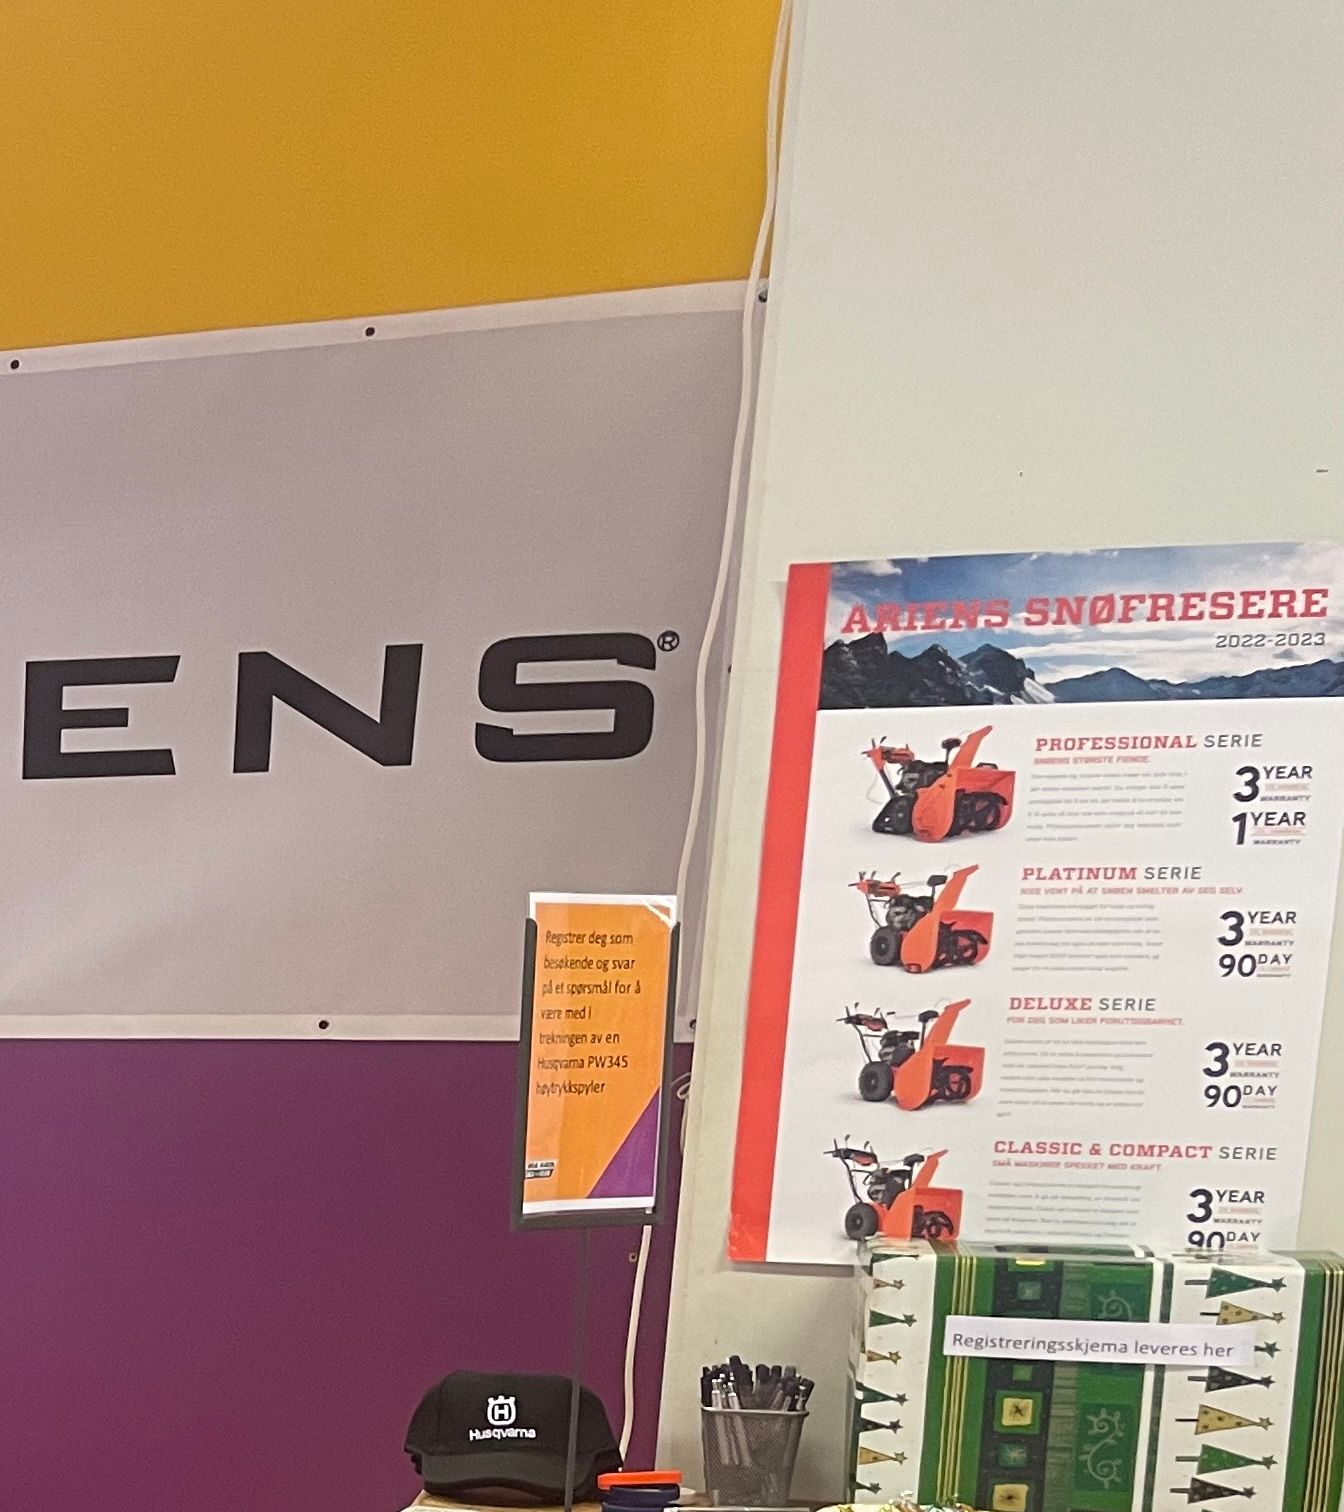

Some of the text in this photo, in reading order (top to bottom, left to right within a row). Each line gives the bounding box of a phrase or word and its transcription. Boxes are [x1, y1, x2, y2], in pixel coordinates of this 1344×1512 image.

[841, 588, 1330, 634] ARIENS SNØFRESERE
[1215, 632, 1326, 648] 2022-2023
[1036, 734, 1263, 751] PROFESSIONAL SERIE
[1232, 766, 1313, 802] 3 YEAR
[1232, 811, 1307, 845] 1 YEAR
[1022, 866, 1202, 880] PLATINUM SERIE
[545, 930, 634, 947] Registrer deg som
[1217, 910, 1297, 947] 3 YEAR
[596, 959, 609, 973] og
[612, 958, 636, 970] svar
[1218, 953, 1293, 977] 90 DAY
[542, 980, 553, 996] på
[566, 979, 612, 996] spørsmål
[614, 980, 631, 994] for
[540, 1008, 562, 1020] være
[564, 1006, 586, 1020] med
[1009, 997, 1156, 1011] DELUXE SERIE
[590, 1034, 603, 1044] av
[605, 1033, 620, 1044] en
[1203, 1042, 1282, 1078] 3 YEAR
[1204, 1085, 1278, 1108] 90 DAY
[994, 1140, 1277, 1161] CLASSIC & COMPACT SERIE
[1187, 1188, 1265, 1223] 3 YEAR
[1188, 1230, 1261, 1250] 90 DAY
[953, 1333, 1233, 1358] Registreringsskjema leveres her
[469, 1427, 537, 1442] Husqvarna
